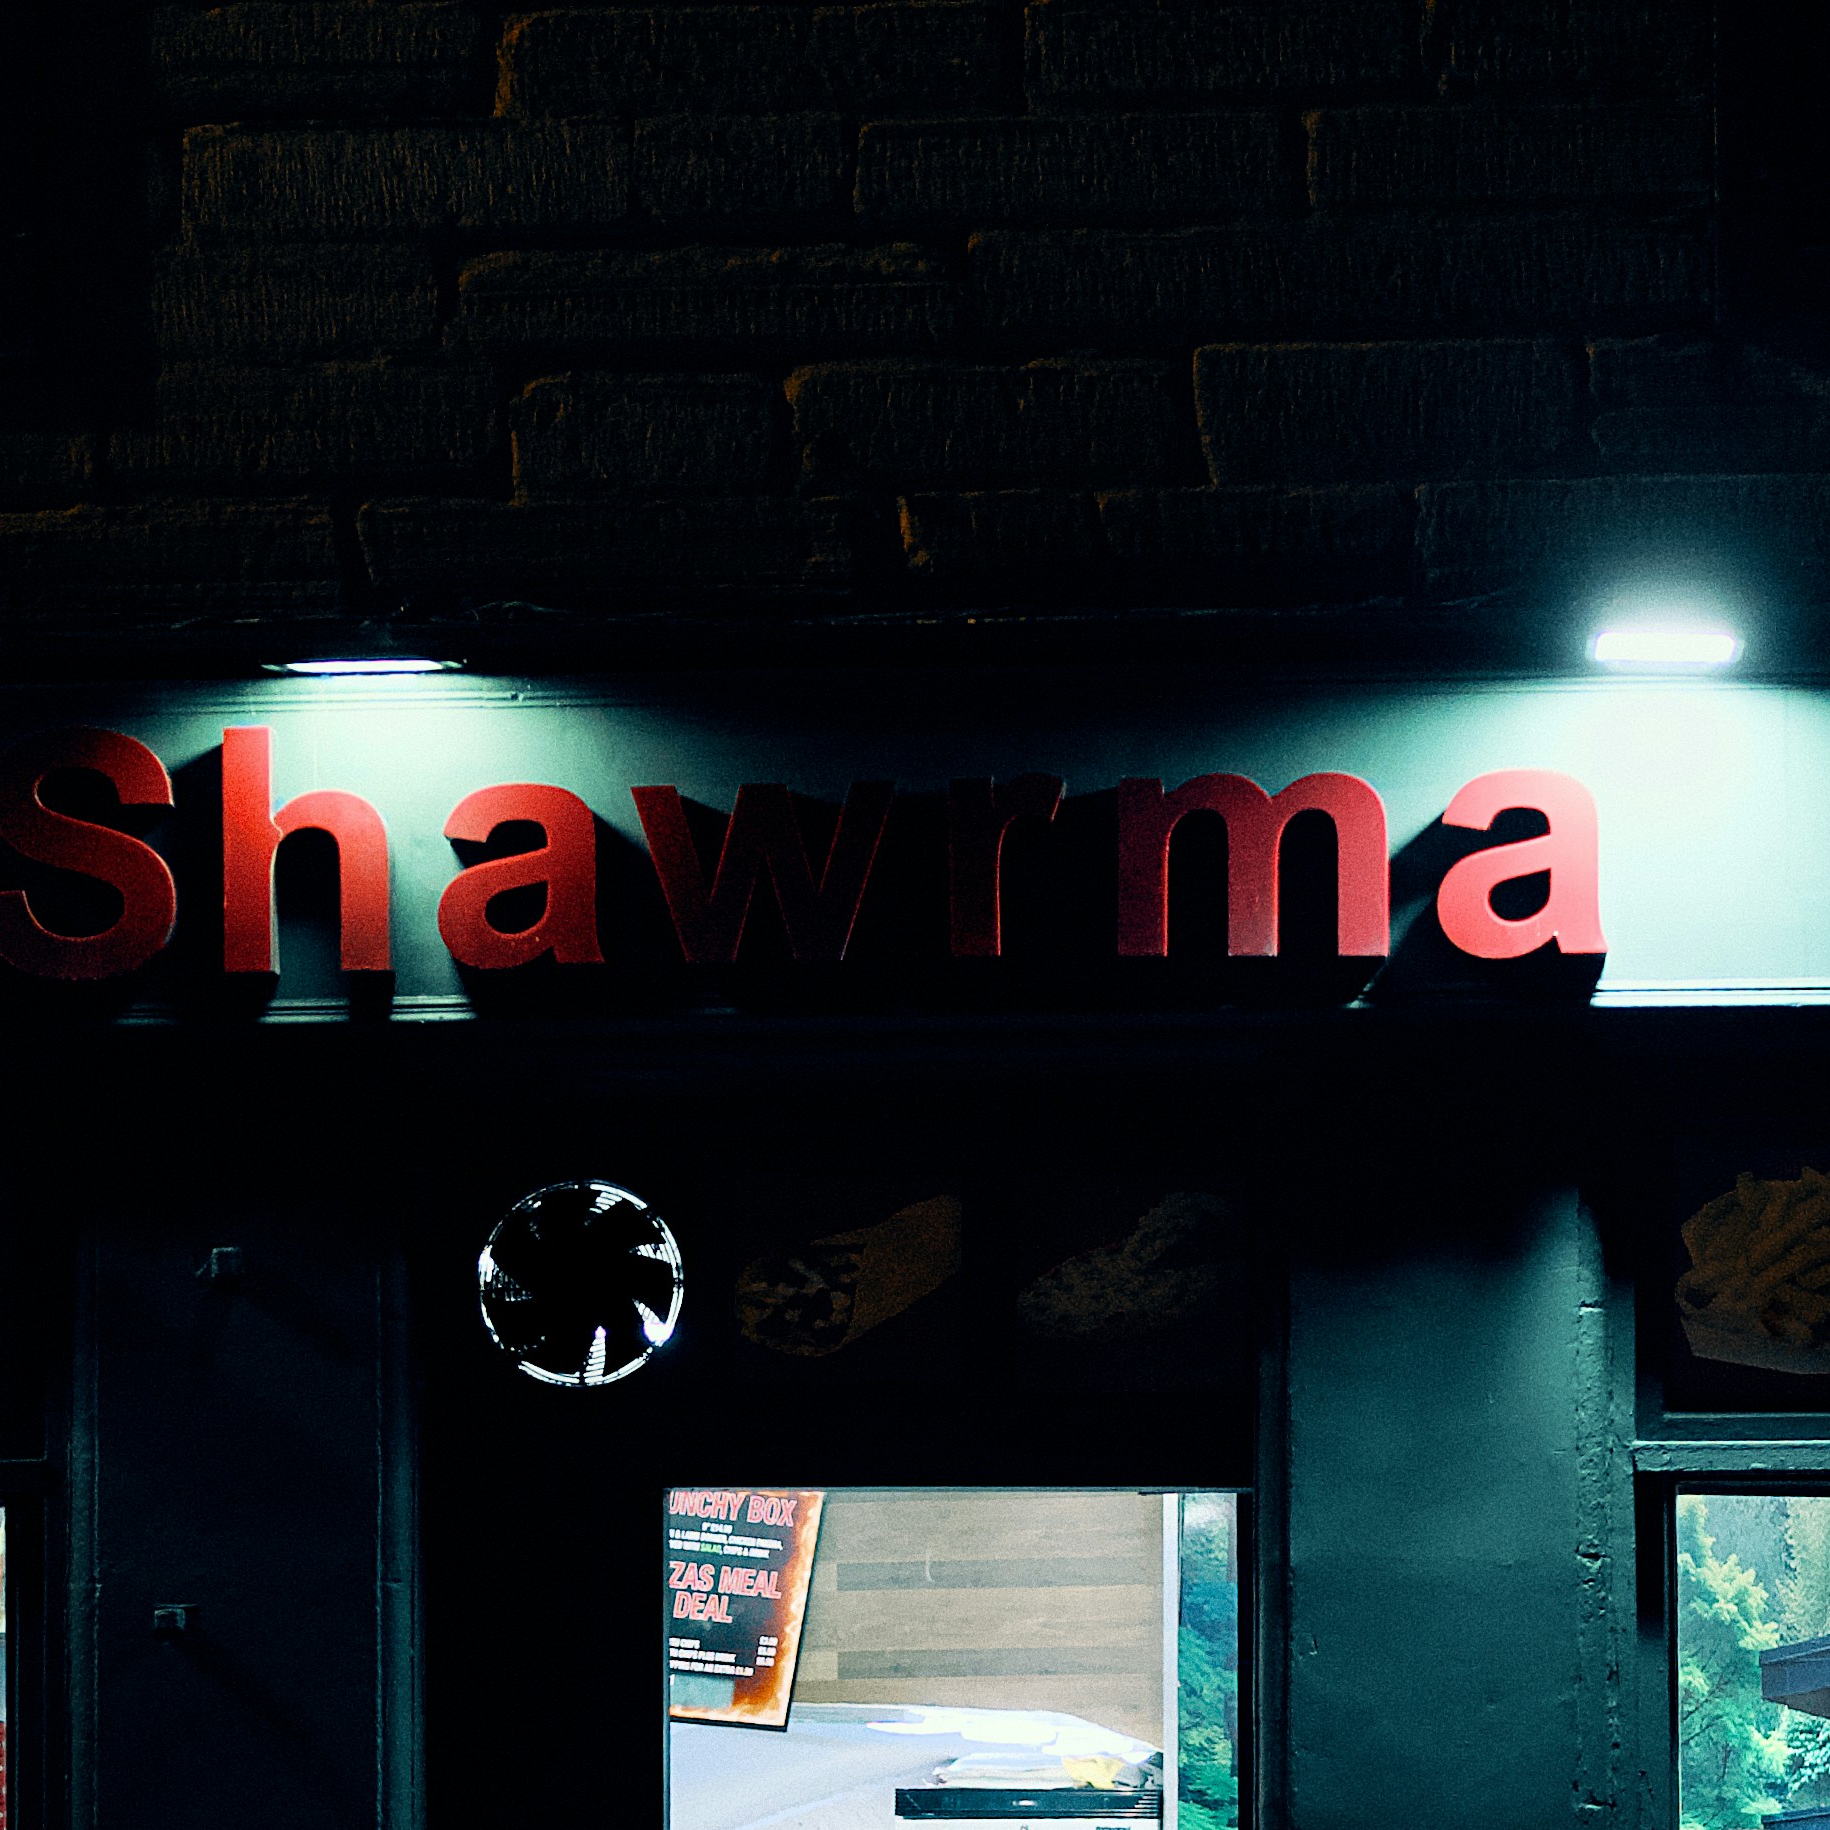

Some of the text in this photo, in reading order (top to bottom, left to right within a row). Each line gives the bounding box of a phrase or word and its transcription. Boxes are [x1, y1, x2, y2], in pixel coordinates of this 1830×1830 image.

[668, 1491, 797, 1527] UNCHY BOX
[668, 1561, 782, 1599] ZAS MEAL
[672, 1591, 733, 1623] DEAL
